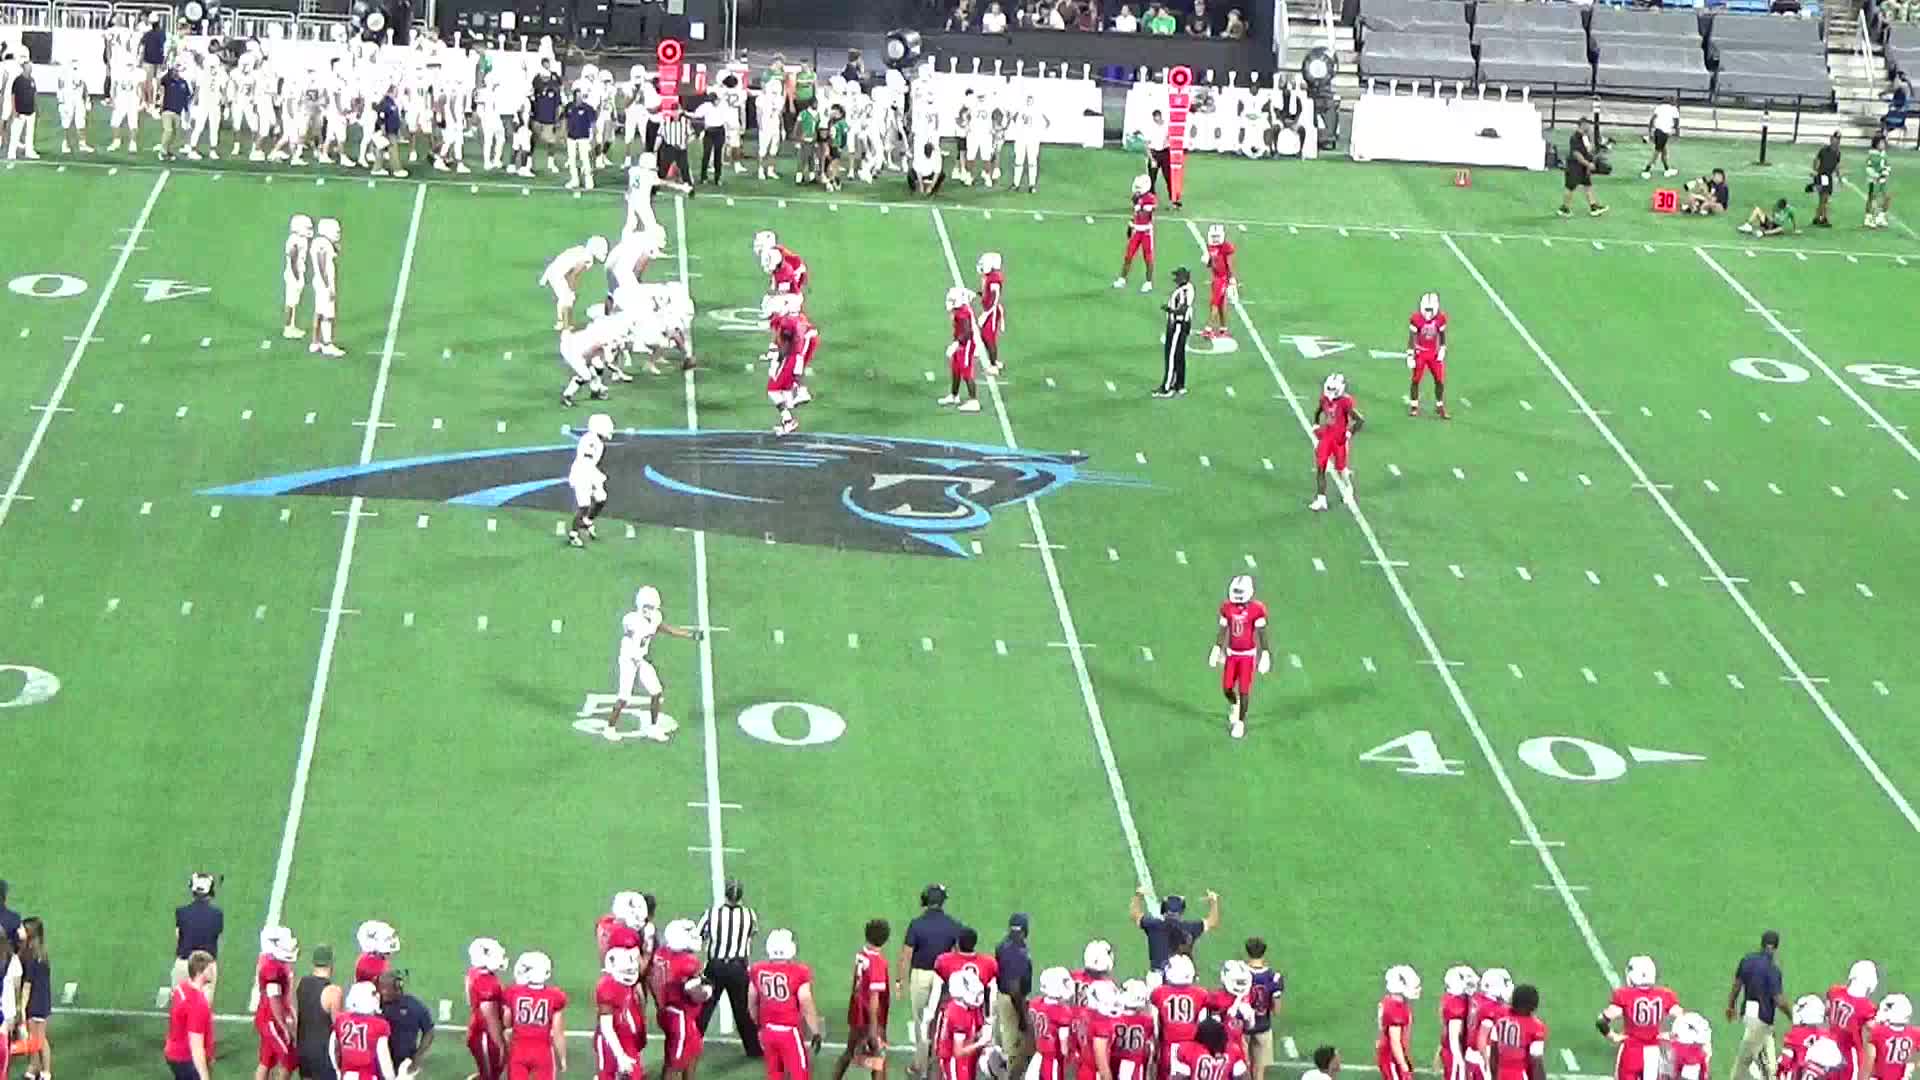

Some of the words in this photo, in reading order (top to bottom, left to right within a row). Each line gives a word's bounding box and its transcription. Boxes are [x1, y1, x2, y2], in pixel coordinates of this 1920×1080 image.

[1657, 191, 1675, 208] 30
[757, 970, 790, 1002] 56
[516, 997, 550, 1026] 54
[1165, 994, 1195, 1024] 19
[1632, 996, 1664, 1026] 61
[1828, 999, 1856, 1029] 17
[340, 1021, 369, 1051] 21
[1112, 1023, 1146, 1052] 86
[1498, 1018, 1521, 1047] 10
[1886, 1035, 1913, 1064] 18
[1195, 1053, 1230, 1080] 67
